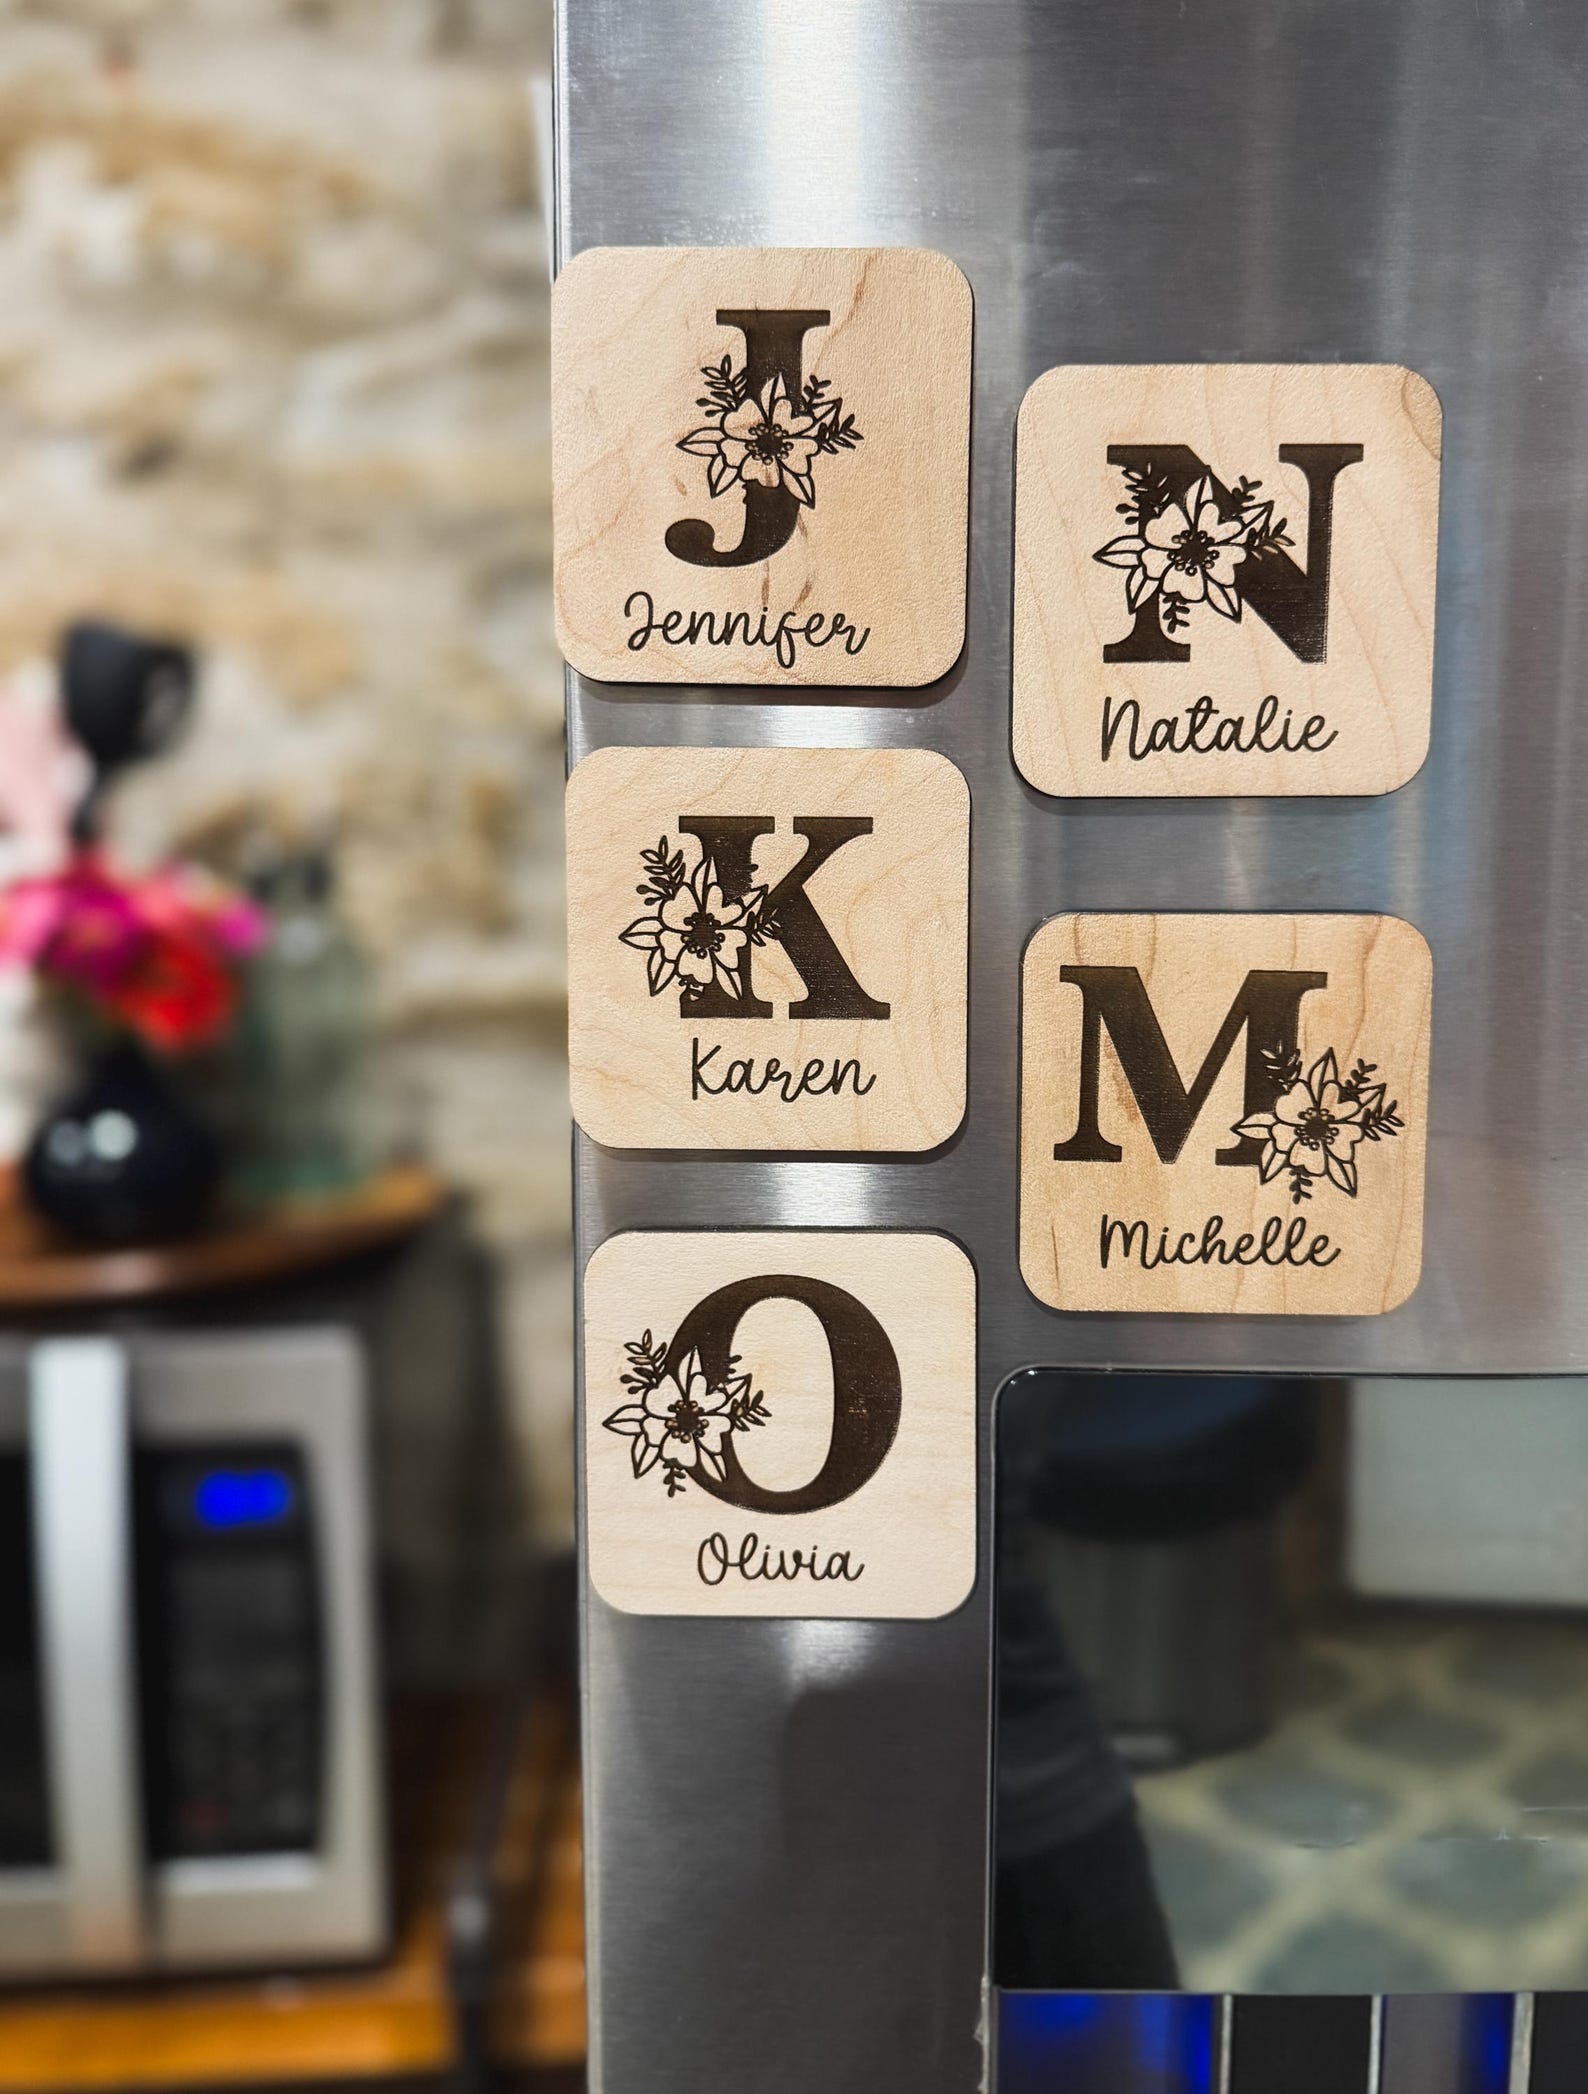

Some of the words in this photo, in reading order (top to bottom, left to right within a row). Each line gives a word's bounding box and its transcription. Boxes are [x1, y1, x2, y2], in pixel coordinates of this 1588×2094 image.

[664, 309, 831, 567] J
[1103, 443, 1364, 664] N
[625, 590, 870, 669] Jennifer
[1102, 695, 1338, 761] Natalie
[679, 816, 890, 1020] K
[692, 1038, 876, 1102] Karen
[1053, 965, 1328, 1166] M
[1101, 1215, 1341, 1269] Michelle
[663, 1274, 902, 1515] O
[698, 1532, 864, 1585] Olivia
